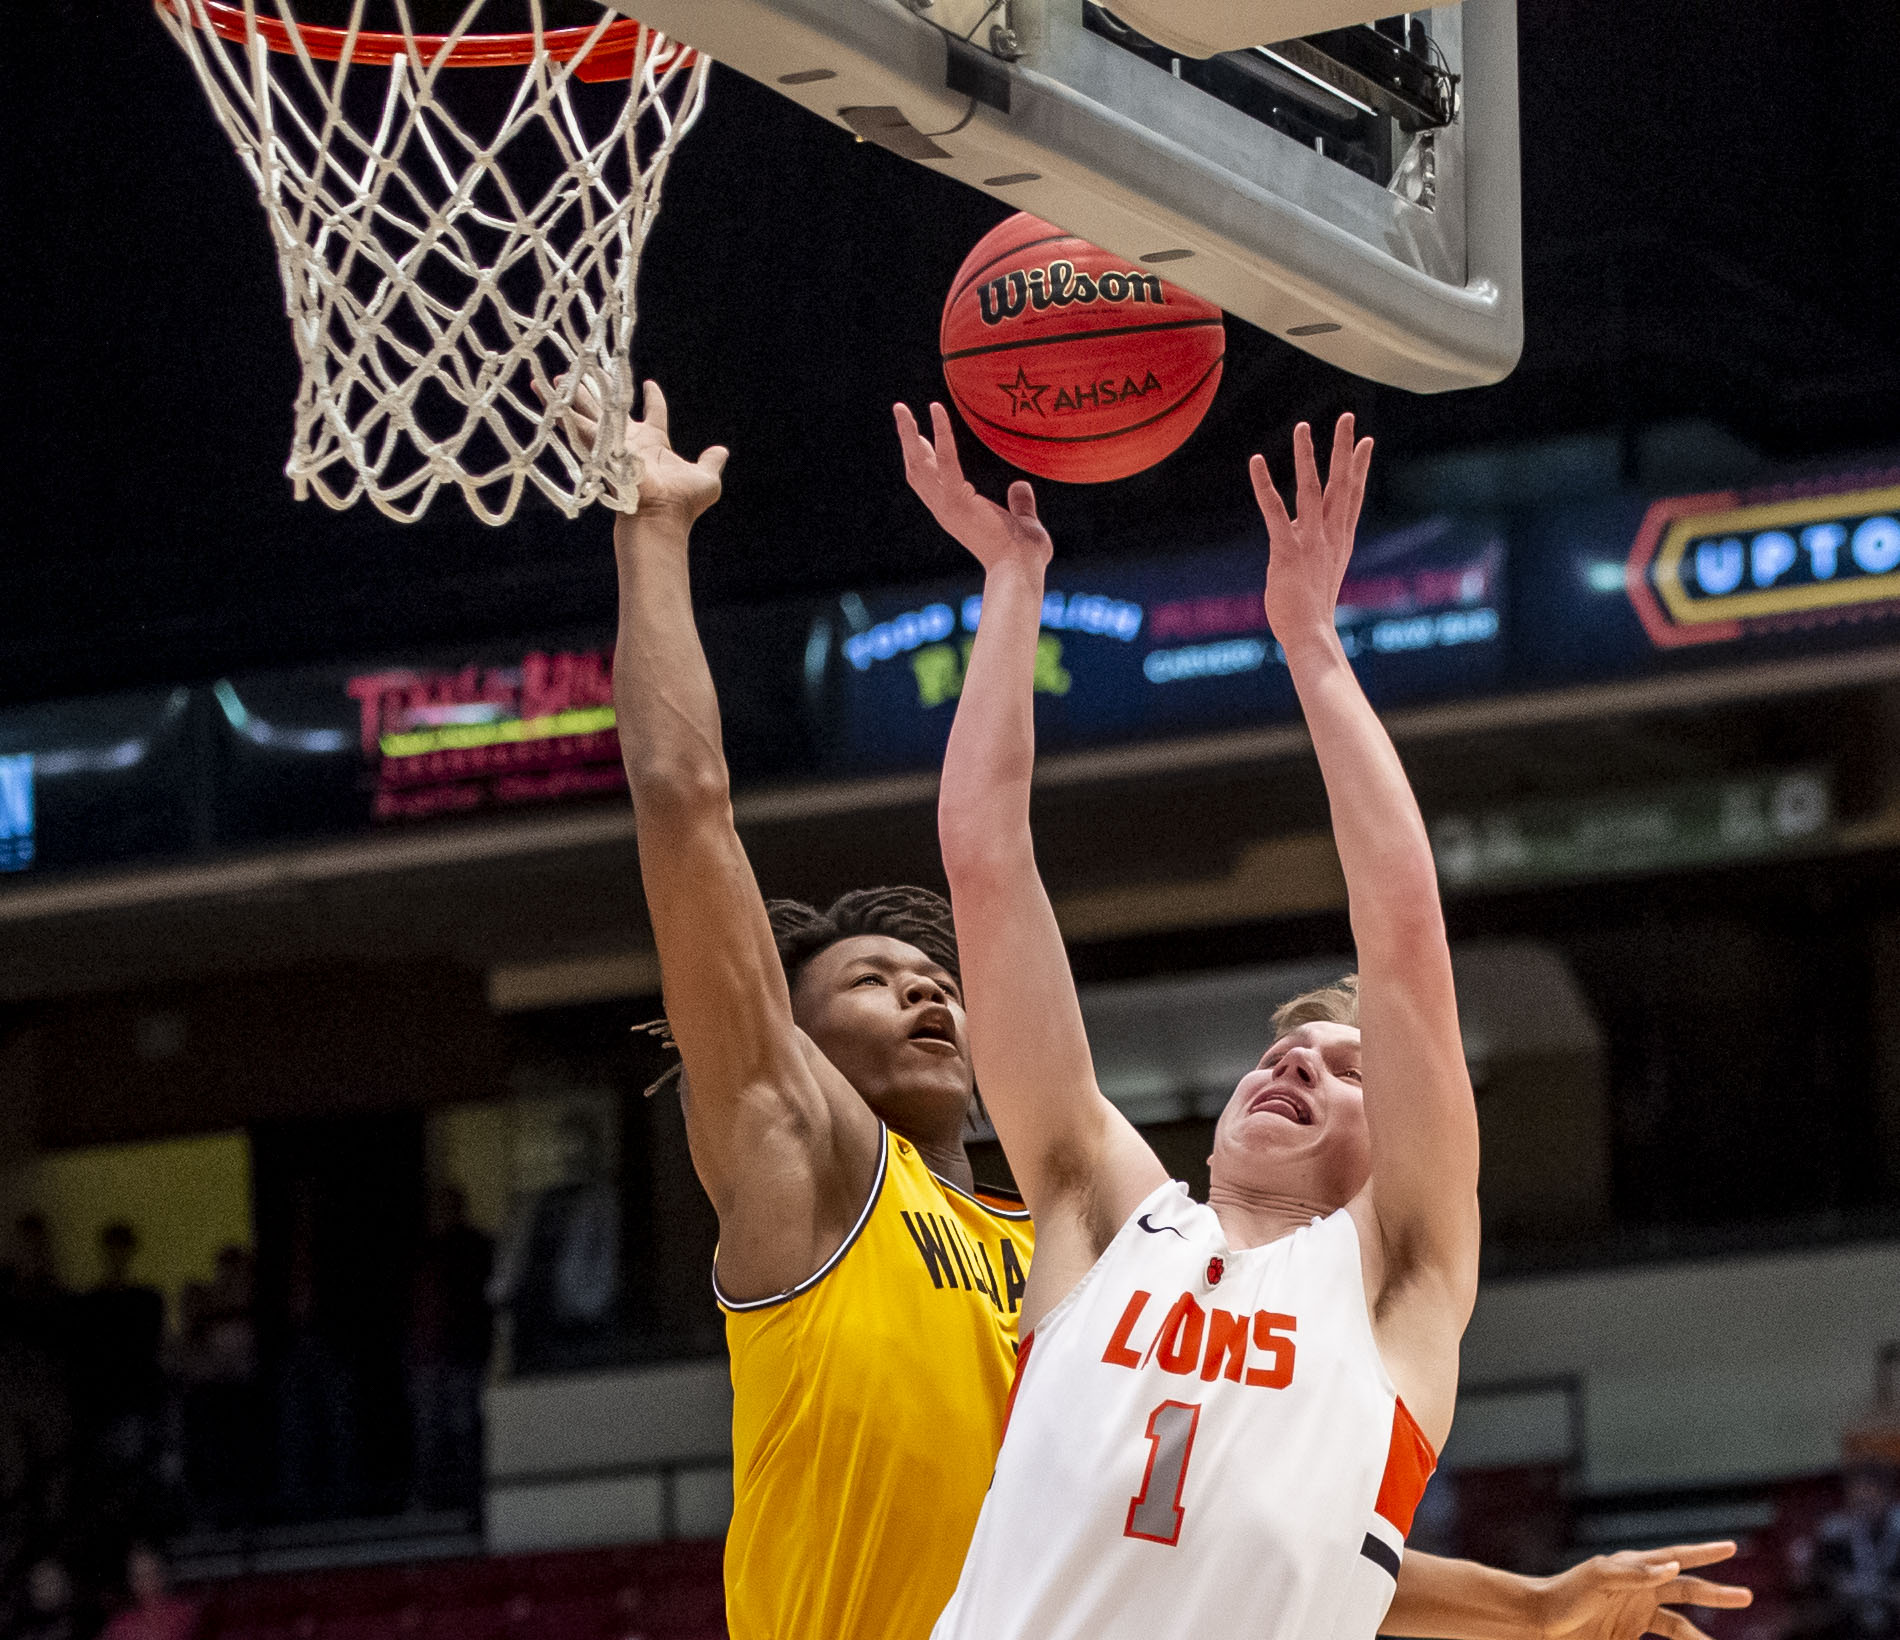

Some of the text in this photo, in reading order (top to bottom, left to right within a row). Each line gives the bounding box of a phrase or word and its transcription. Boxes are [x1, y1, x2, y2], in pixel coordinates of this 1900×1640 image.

[977, 260, 1165, 326] Wilson
[1054, 369, 1163, 412] AHSAA
[1695, 515, 1900, 596] UPTO
[1101, 1289, 1297, 1390] LONS
[1123, 1399, 1202, 1547] 1
